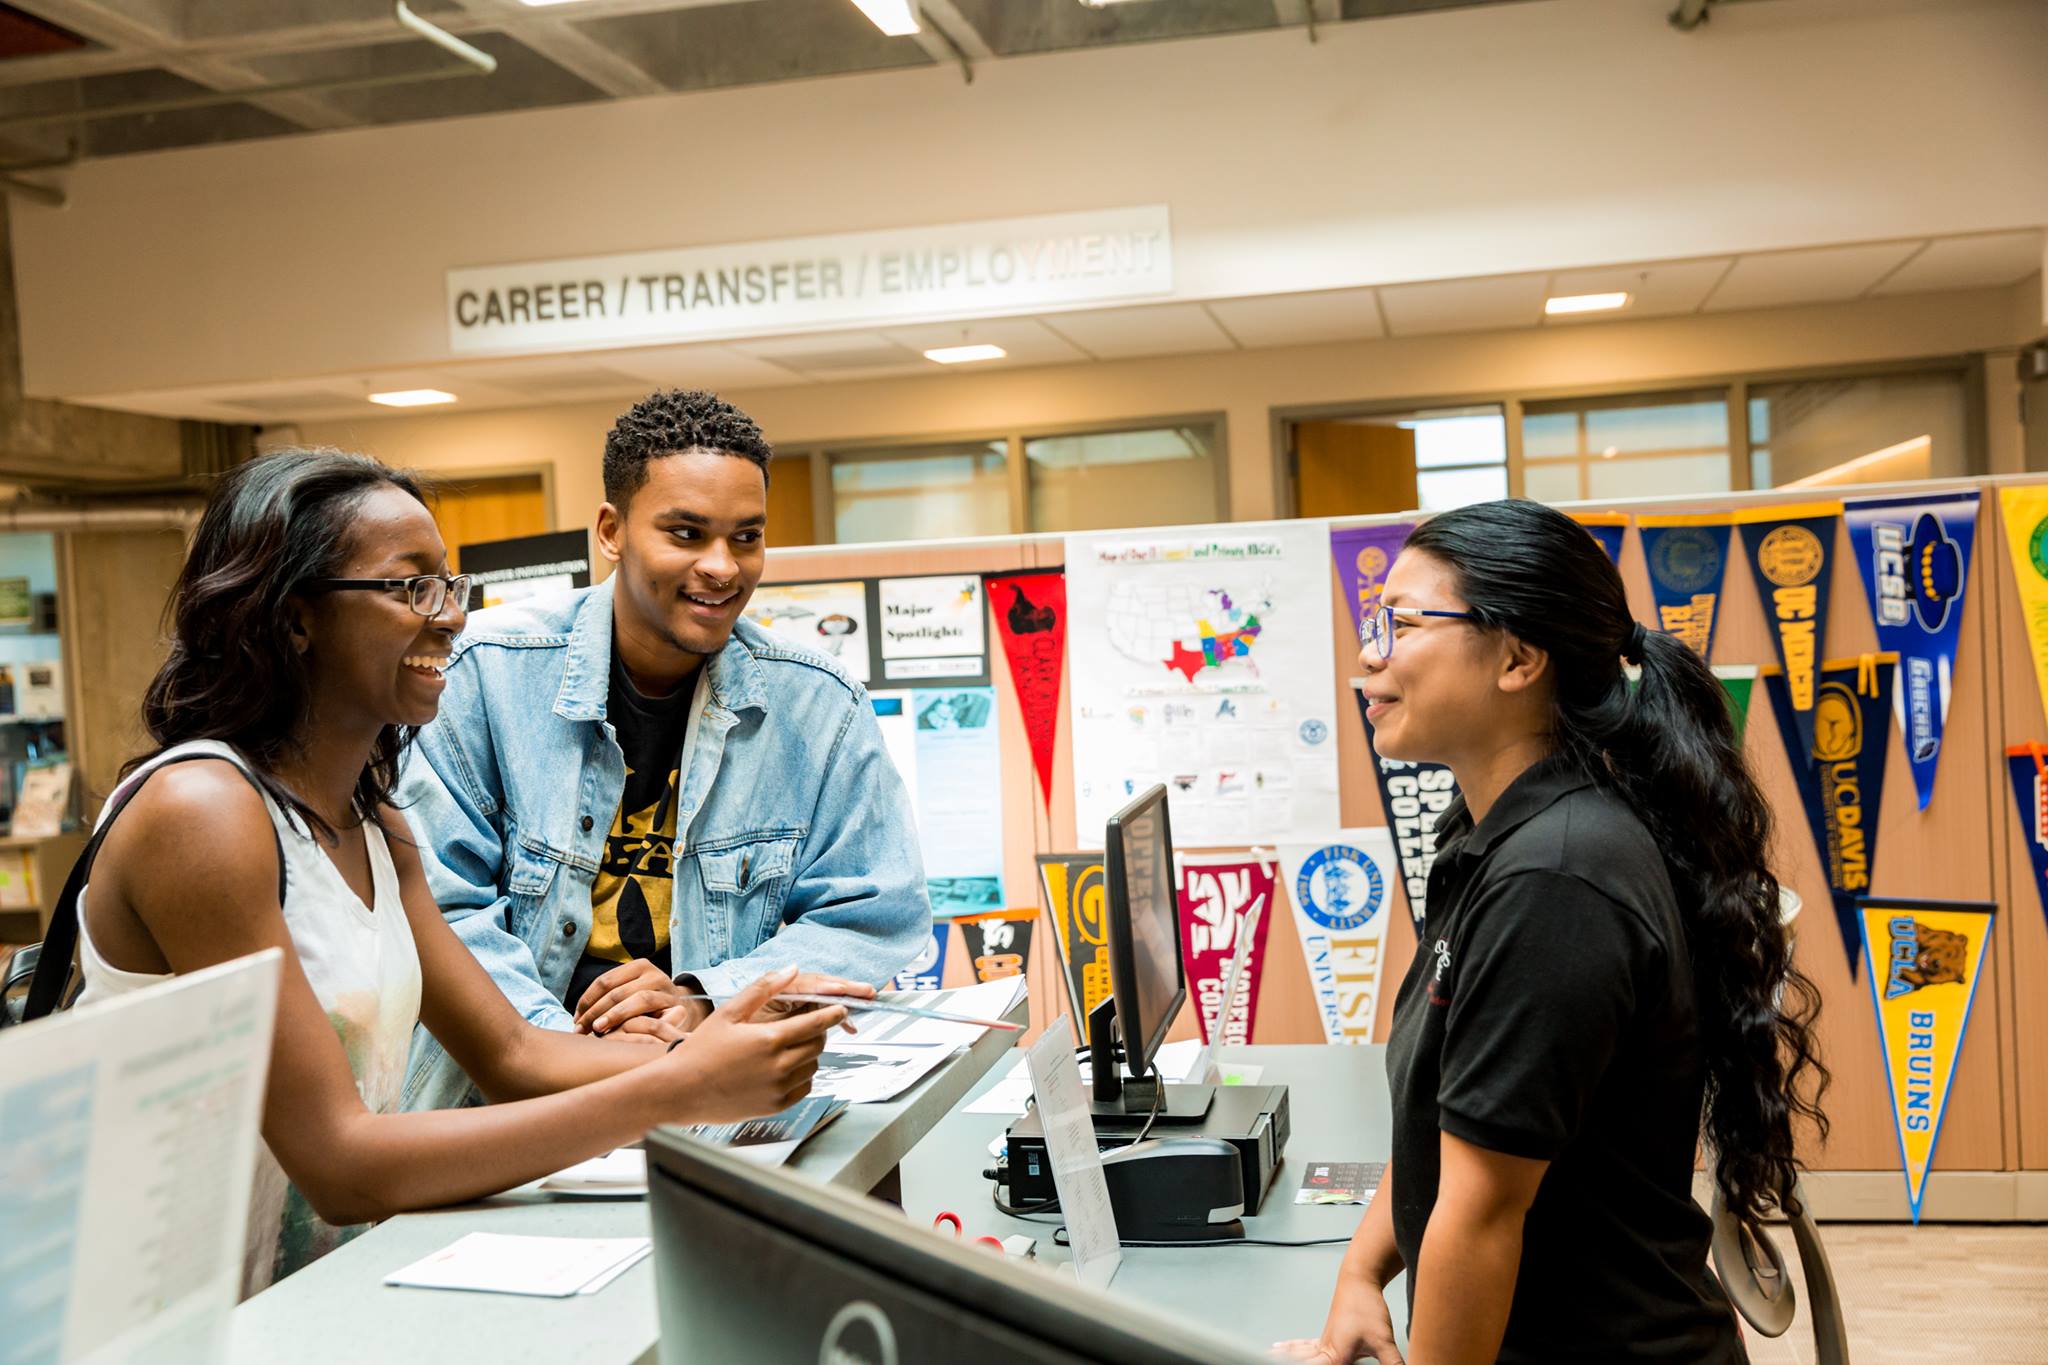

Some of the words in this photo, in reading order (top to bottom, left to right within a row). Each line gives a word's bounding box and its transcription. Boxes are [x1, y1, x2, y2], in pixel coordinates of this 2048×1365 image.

[455, 278, 606, 329] CAREER
[638, 257, 844, 313] TRANSFER
[879, 229, 1162, 295] EMPLOYMENT
[885, 604, 933, 618] Major
[1772, 584, 1816, 620] UC
[1876, 525, 1907, 623] UCSB
[1778, 619, 1816, 711] MERCED
[1386, 775, 1425, 923] COLLEGE
[1885, 915, 1918, 1000] UCLA
[1906, 1010, 1934, 1133] BRUINS
